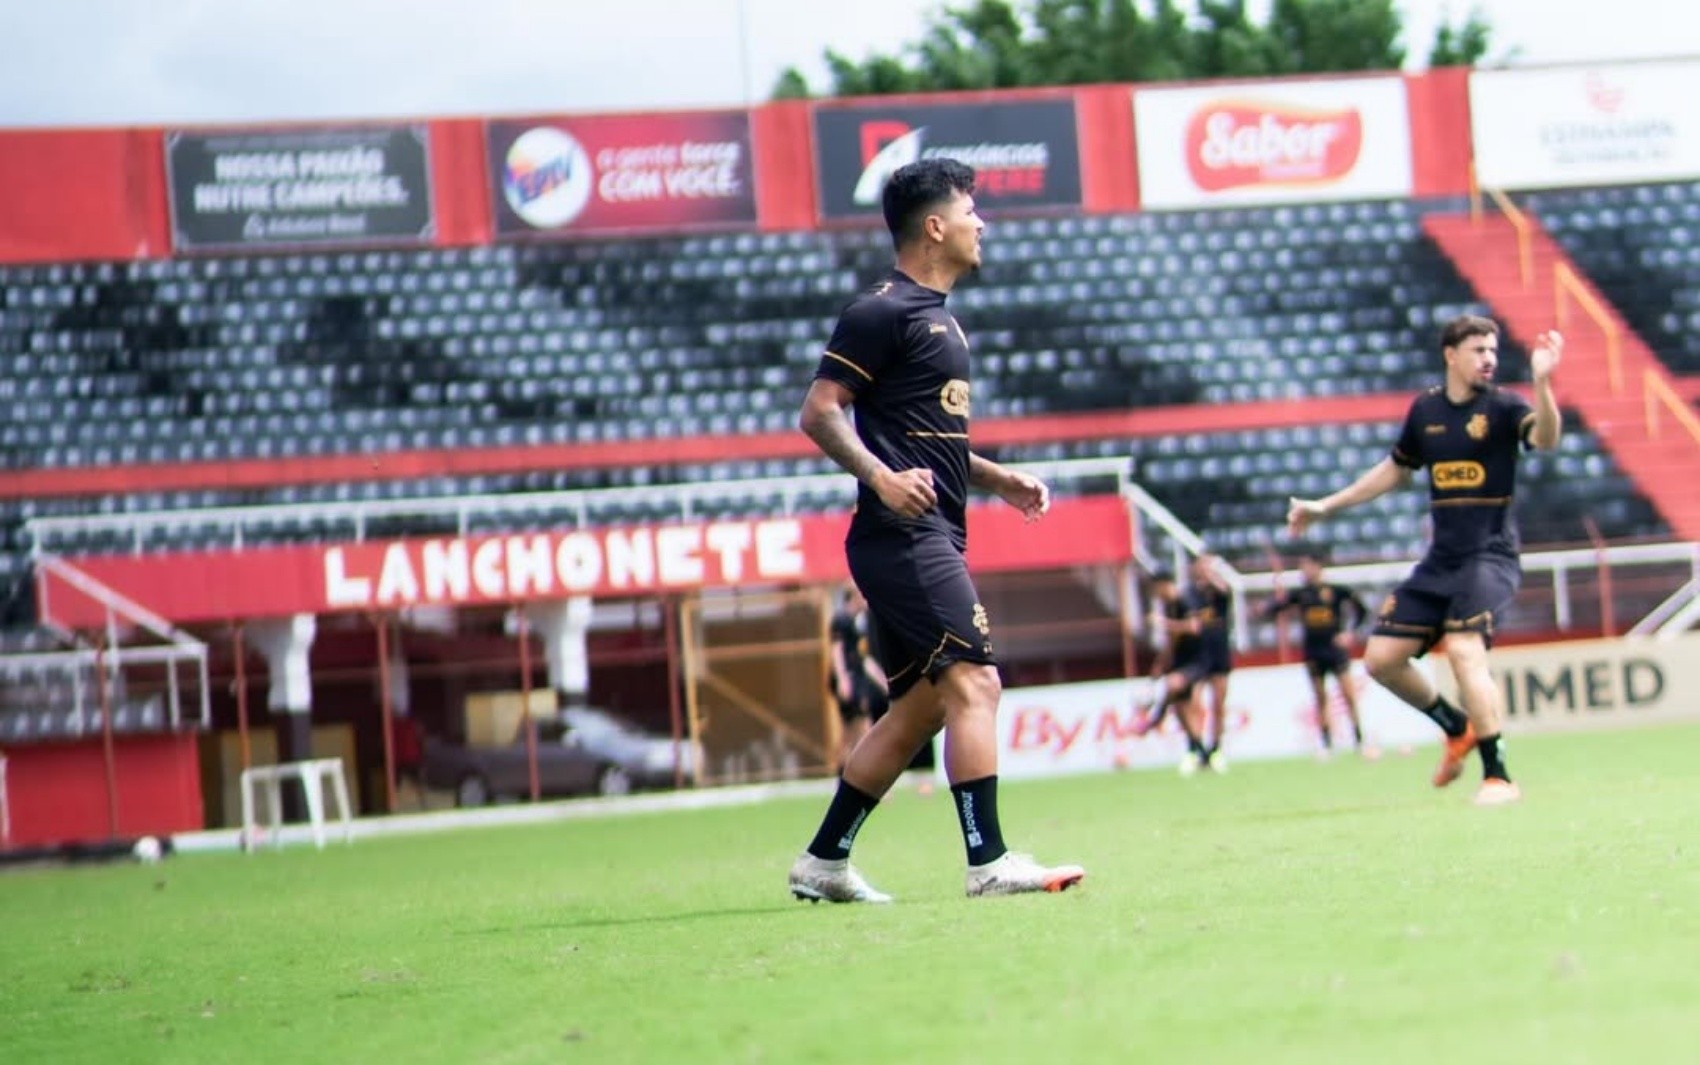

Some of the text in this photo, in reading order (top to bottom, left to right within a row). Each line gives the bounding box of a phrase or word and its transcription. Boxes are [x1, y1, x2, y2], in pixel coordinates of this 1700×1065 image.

[1201, 111, 1348, 169] Sabor
[598, 170, 663, 201] COM
[1435, 466, 1479, 482] CIMED
[324, 520, 804, 607] LANCHONETE
[1501, 657, 1665, 717] IMED
